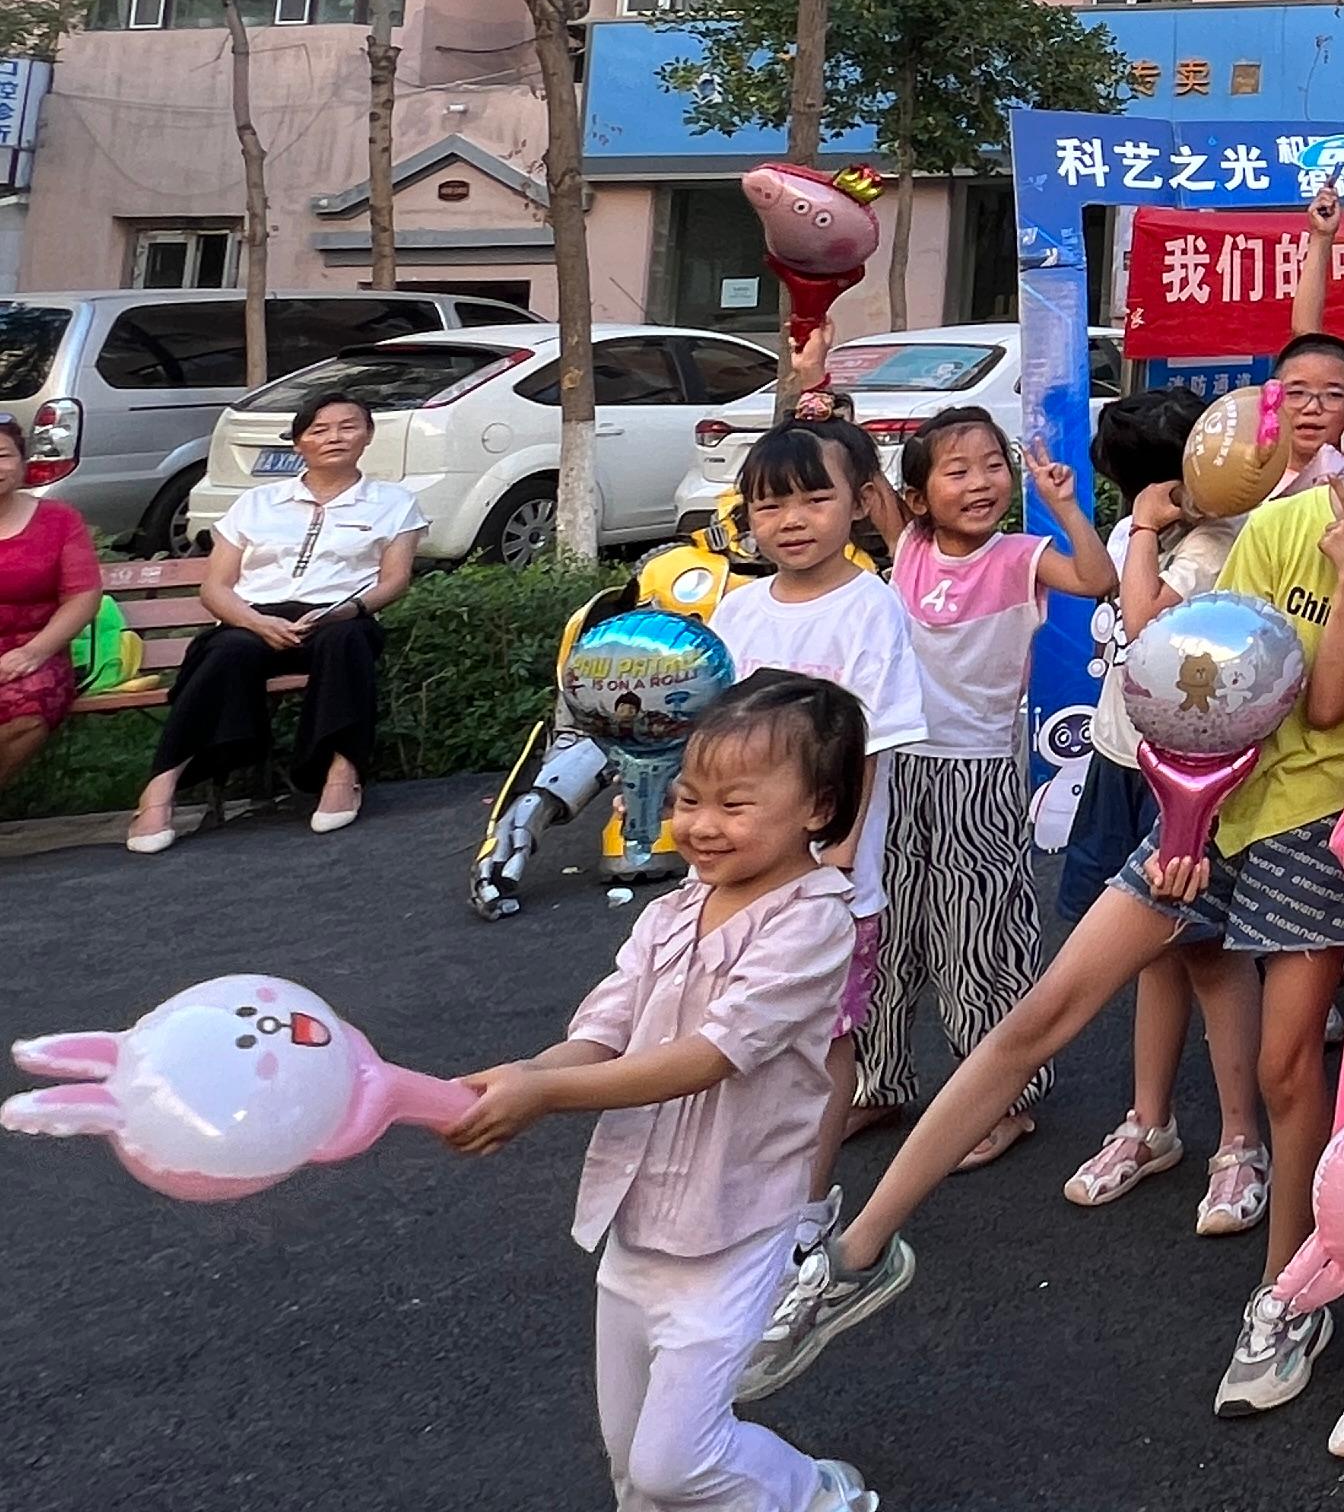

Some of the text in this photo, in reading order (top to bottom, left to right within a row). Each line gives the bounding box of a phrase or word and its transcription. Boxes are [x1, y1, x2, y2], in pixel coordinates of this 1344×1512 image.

[1055, 136, 1271, 192] 科艺之光
[592, 679, 604, 691] IS
[607, 679, 629, 691] ON
[633, 679, 645, 690] A
